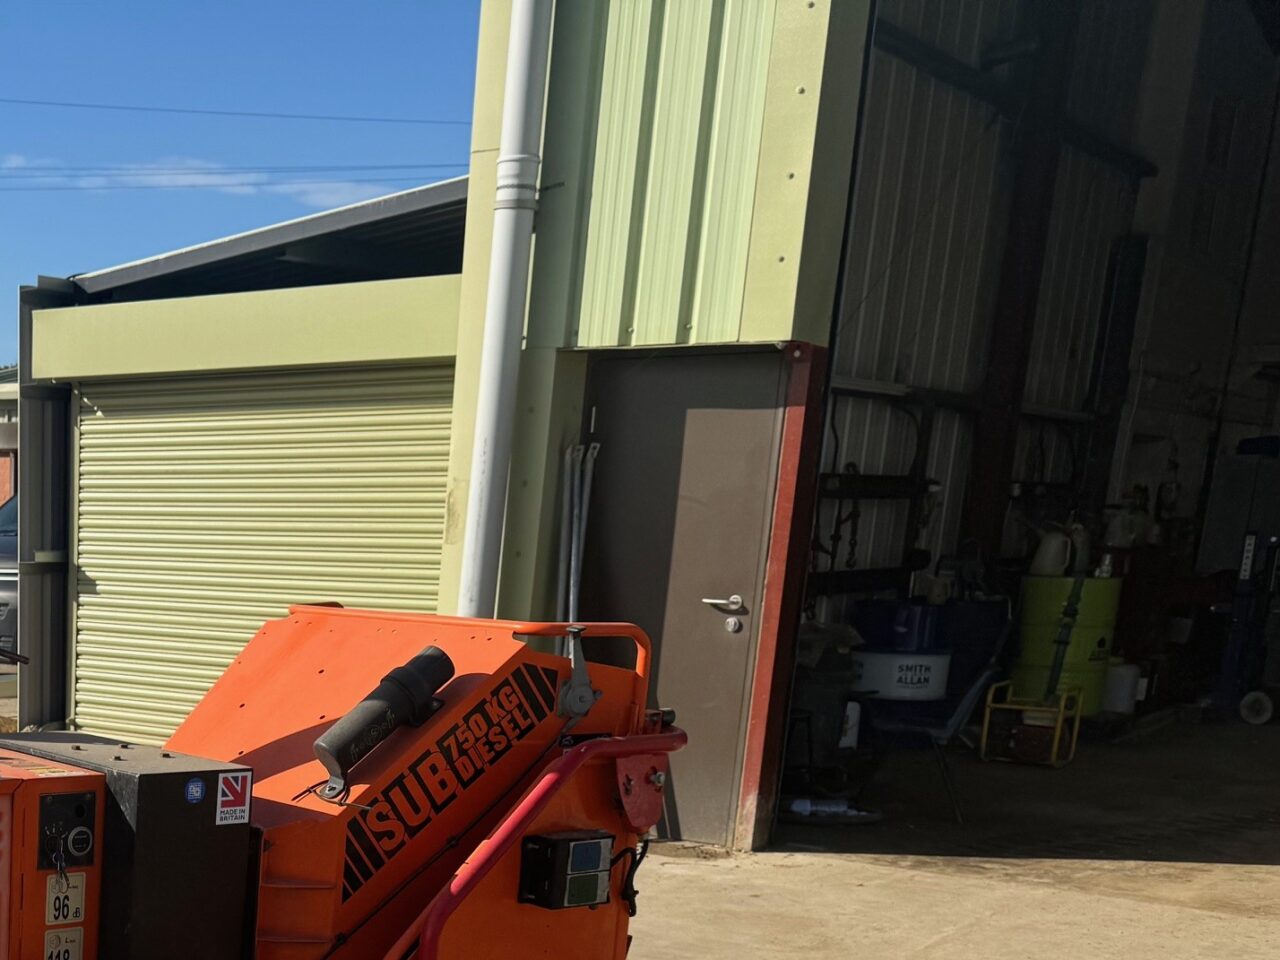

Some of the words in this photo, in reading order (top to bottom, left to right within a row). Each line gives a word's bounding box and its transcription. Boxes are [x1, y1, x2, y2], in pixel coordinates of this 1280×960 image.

[896, 676, 930, 685] ALLAN
[898, 664, 932, 673] SMITH
[442, 712, 488, 762] 750
[484, 685, 521, 727] KG
[454, 705, 533, 783] DIESEL
[365, 750, 461, 852] SUB
[53, 894, 70, 920] 96
[72, 907, 81, 918] dB
